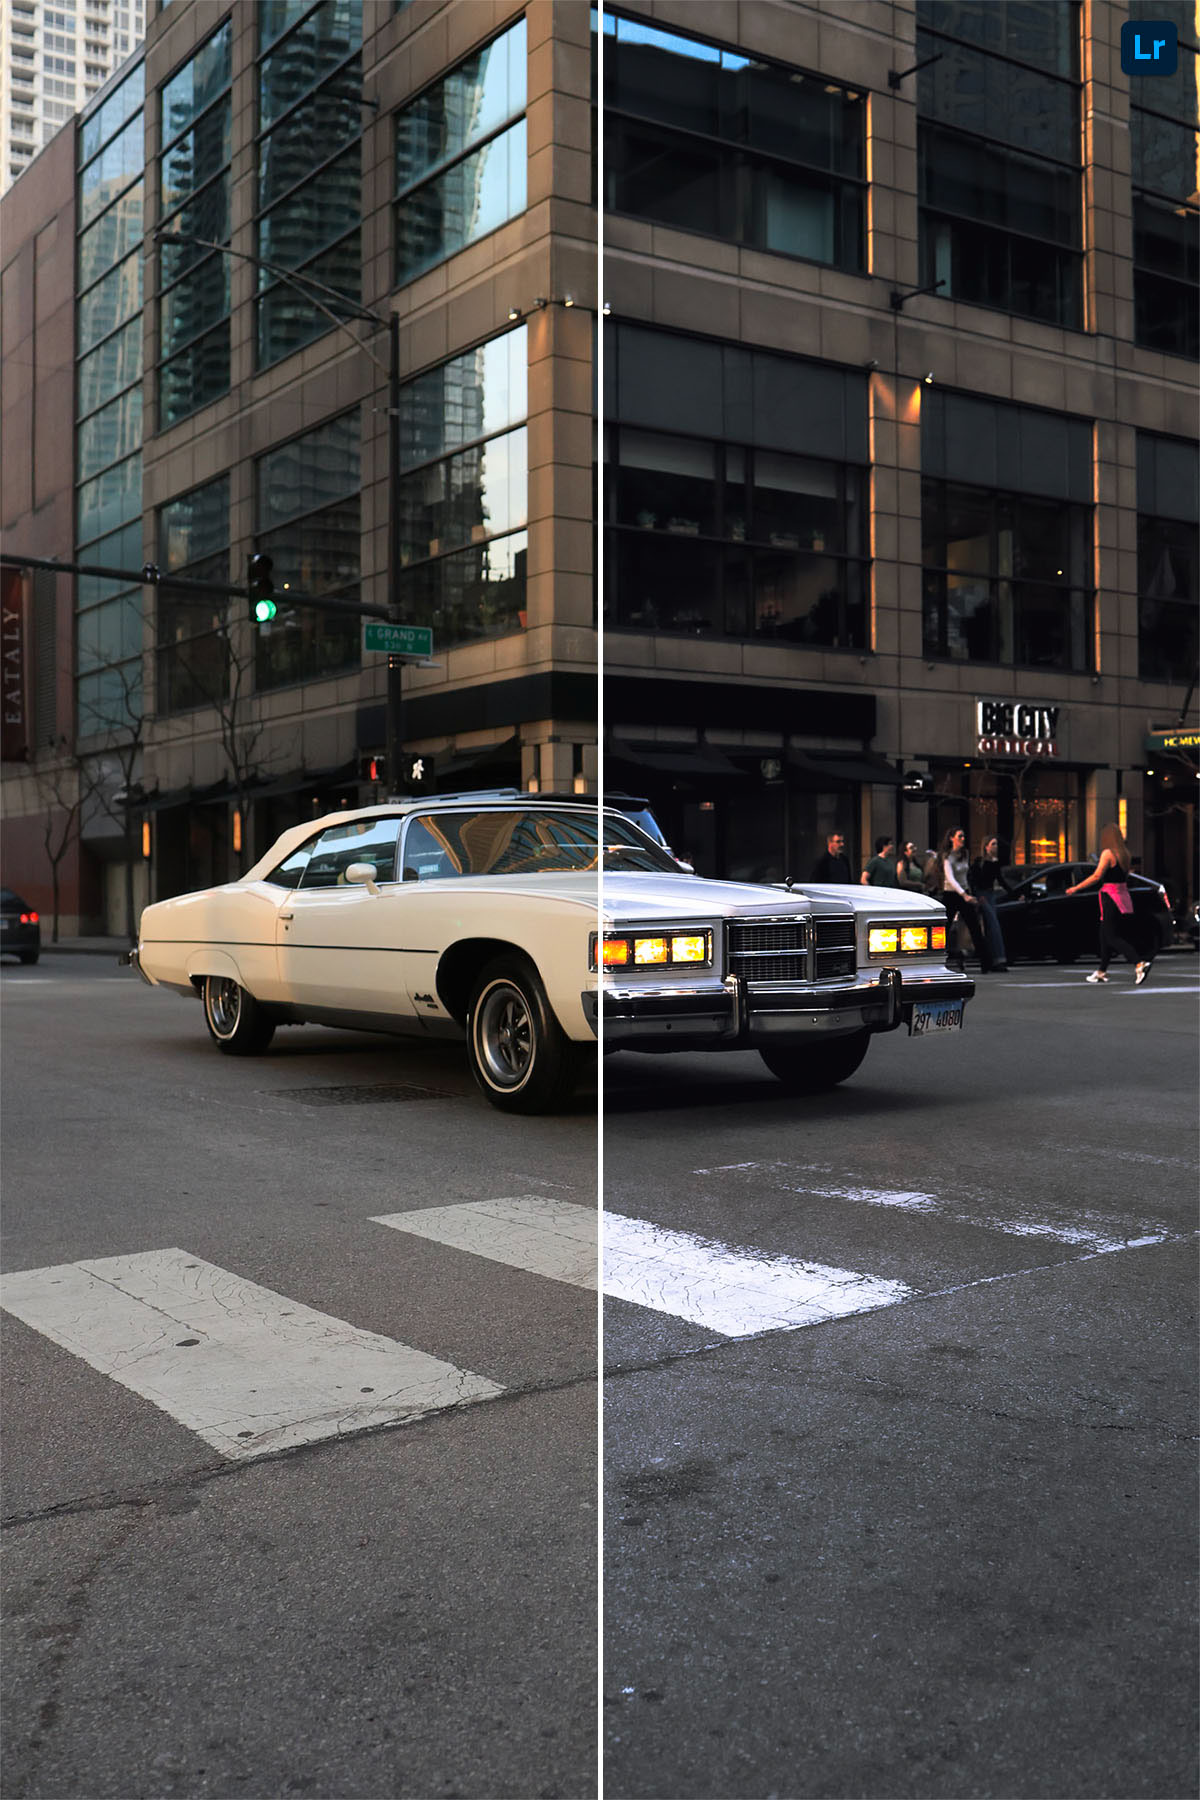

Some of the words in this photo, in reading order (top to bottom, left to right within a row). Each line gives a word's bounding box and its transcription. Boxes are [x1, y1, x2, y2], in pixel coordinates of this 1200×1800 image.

[377, 628, 415, 642] GRAND
[3, 607, 21, 724] EATALY
[978, 701, 1013, 737] BIG
[1013, 703, 1060, 739] CITY
[914, 1012, 932, 1031] 297
[936, 1009, 960, 1027] 4080
